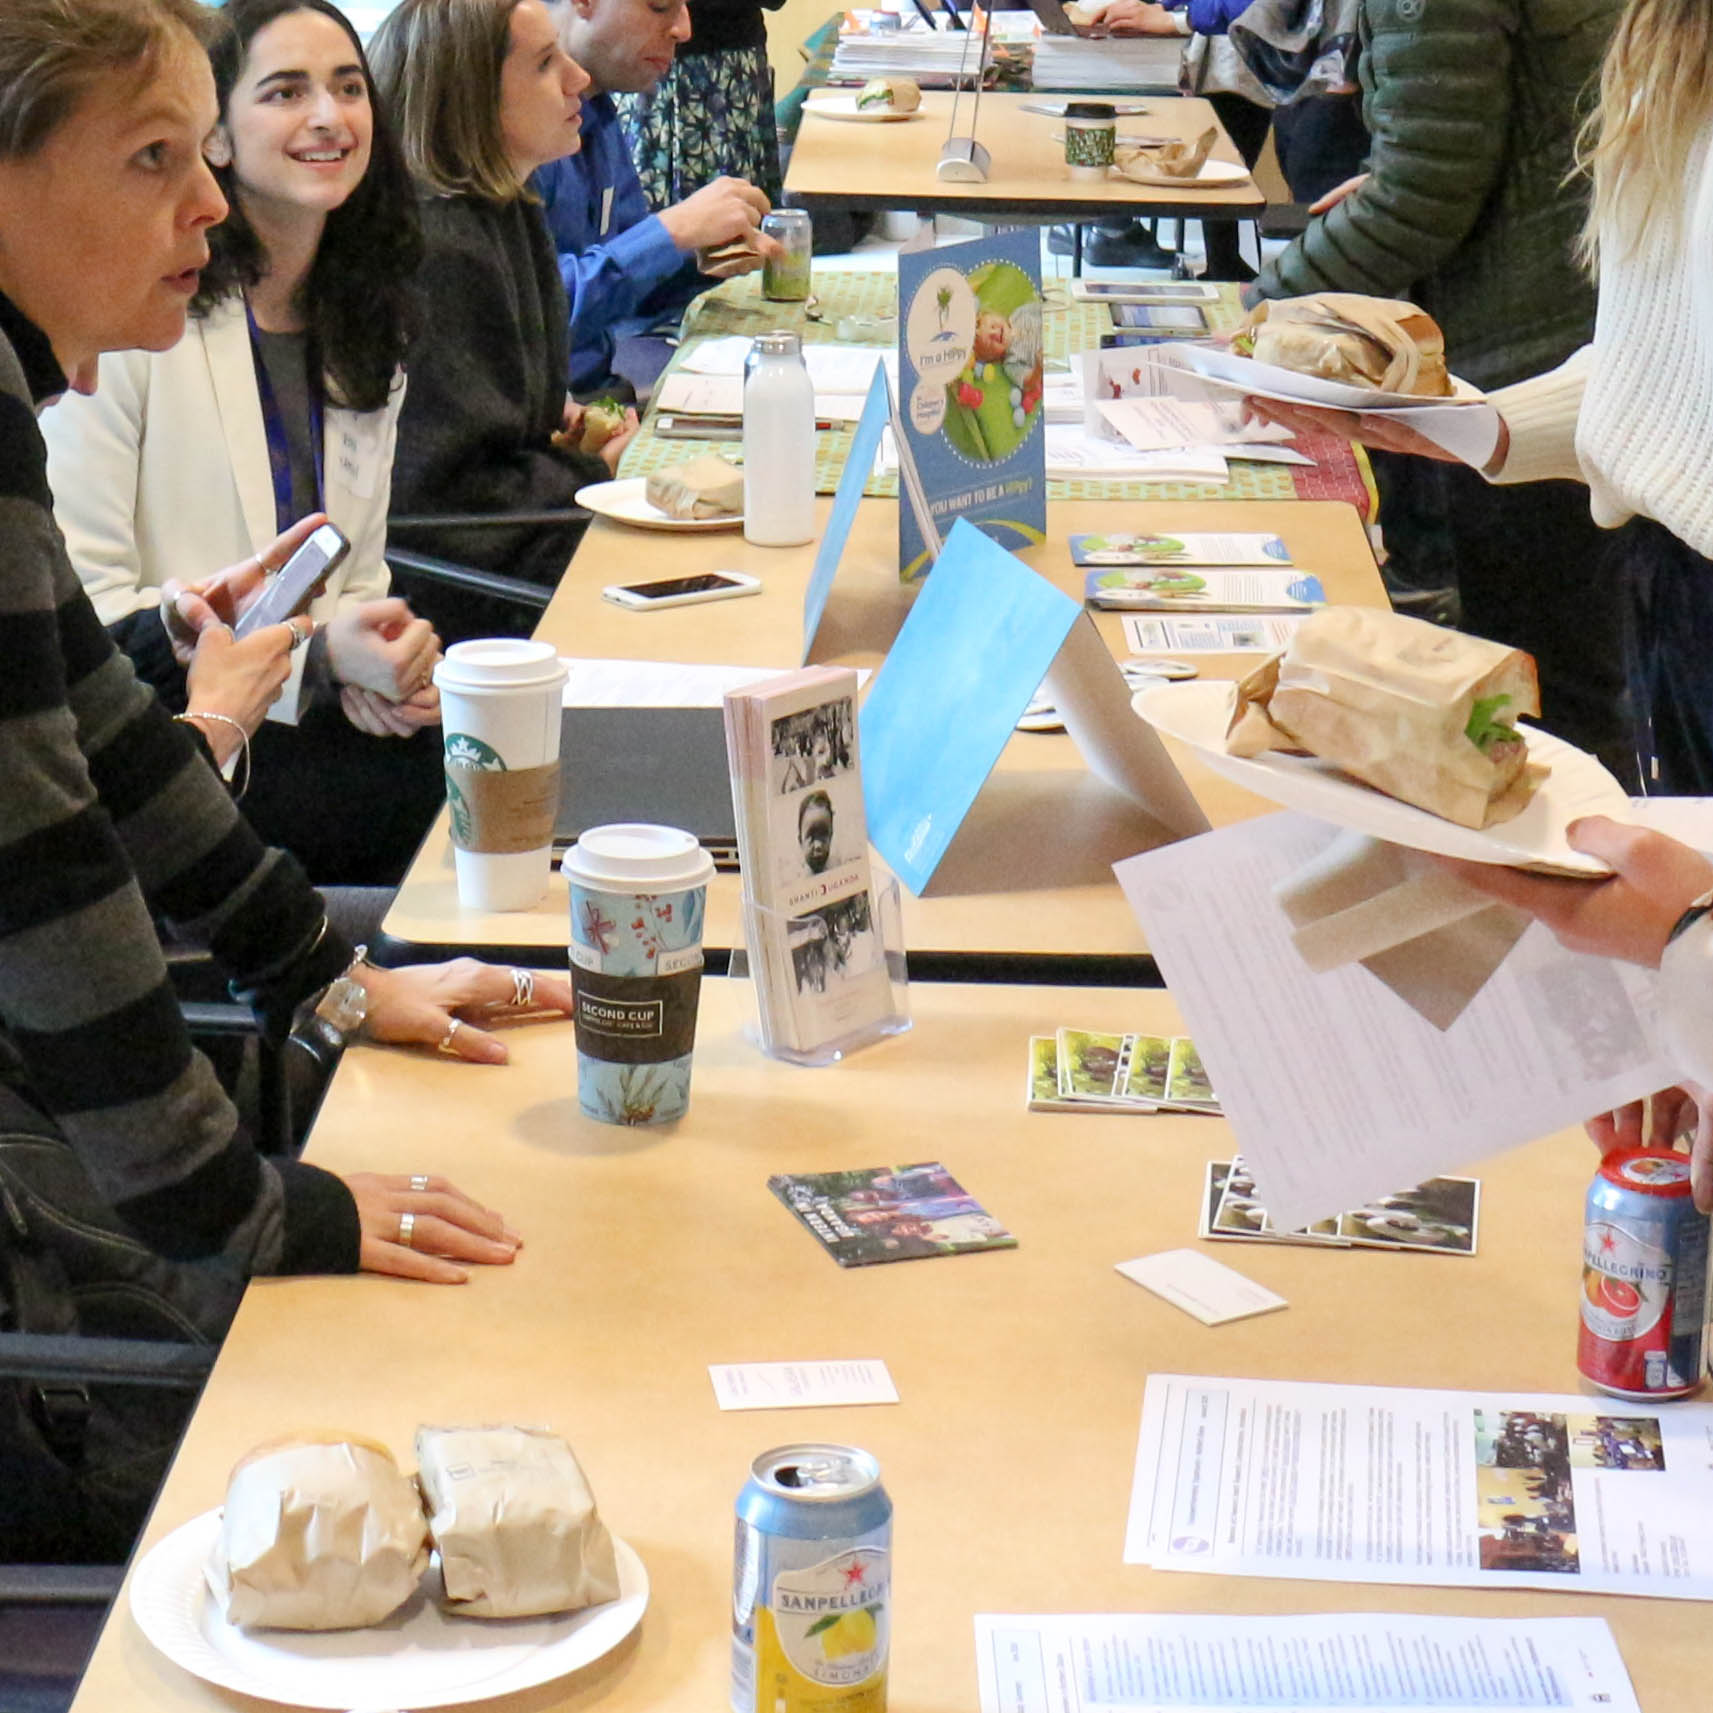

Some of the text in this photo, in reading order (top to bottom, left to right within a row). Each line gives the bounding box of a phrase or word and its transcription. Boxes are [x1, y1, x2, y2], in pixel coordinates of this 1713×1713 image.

[930, 501, 948, 516] YOU
[948, 493, 973, 511] WANT
[974, 490, 986, 505] TO
[987, 486, 998, 502] BE
[998, 484, 1005, 498] A
[582, 1001, 626, 1020] SECOND
[628, 1010, 655, 1021] CUP
[1585, 1253, 1668, 1280] PELLEGRINO
